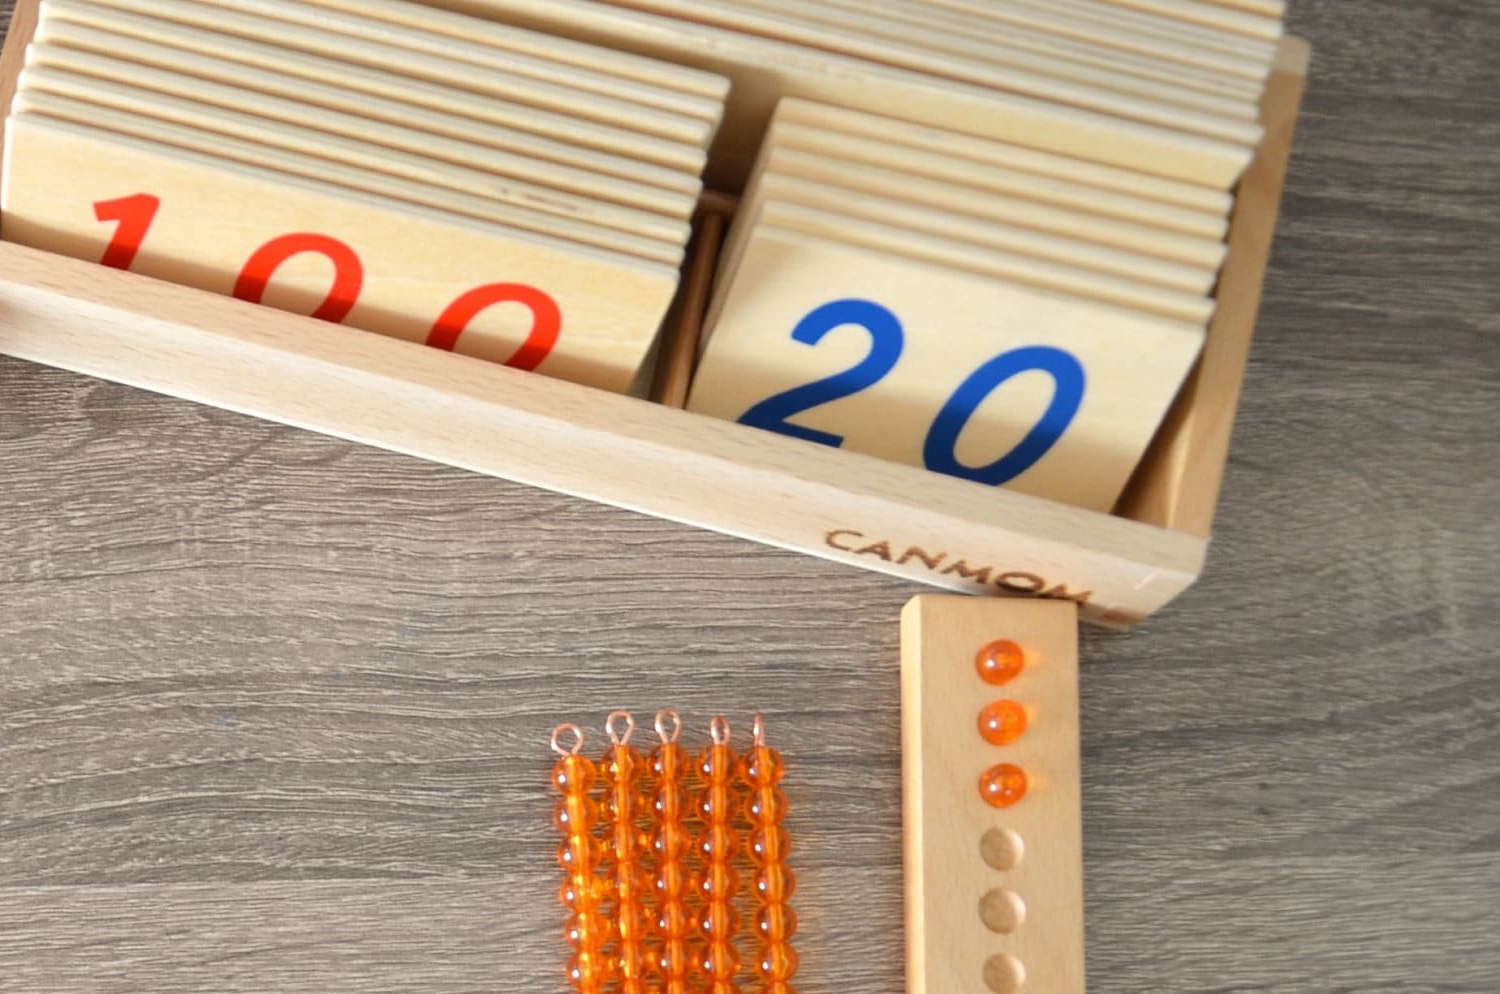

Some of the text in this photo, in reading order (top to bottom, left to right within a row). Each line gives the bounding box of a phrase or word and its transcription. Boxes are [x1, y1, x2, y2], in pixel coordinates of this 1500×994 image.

[93, 193, 562, 371] 100
[736, 298, 1086, 486] 20
[825, 529, 1092, 606] CANMOM
